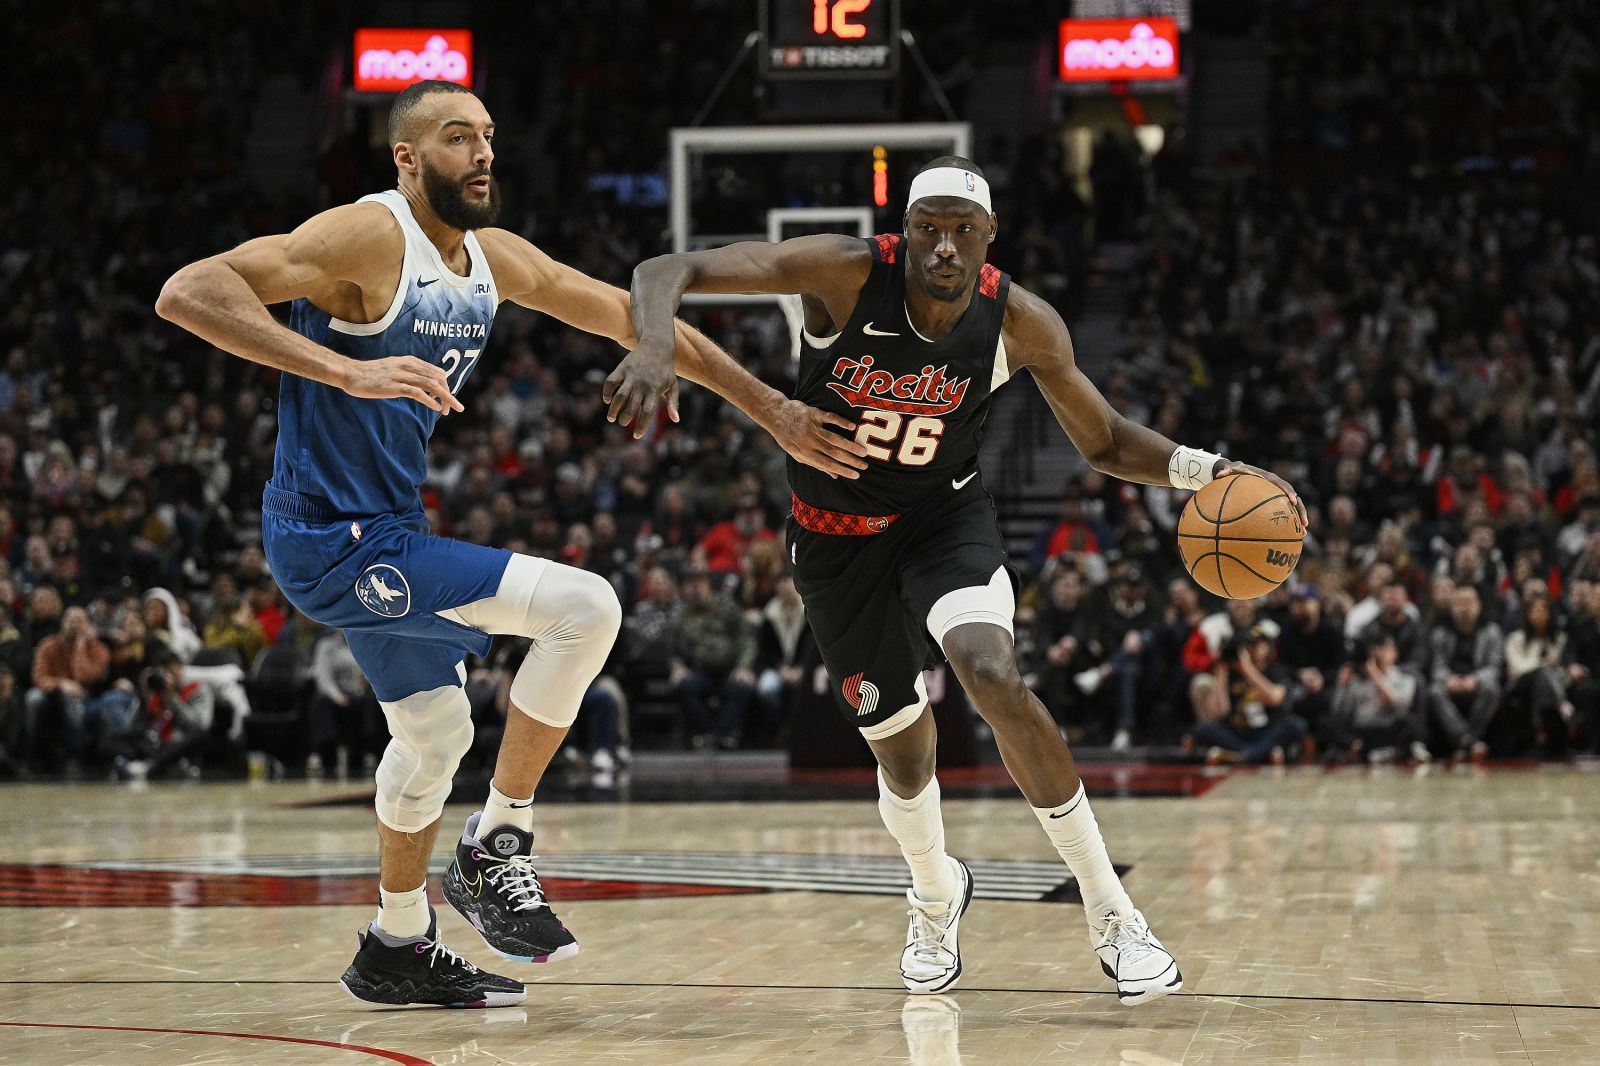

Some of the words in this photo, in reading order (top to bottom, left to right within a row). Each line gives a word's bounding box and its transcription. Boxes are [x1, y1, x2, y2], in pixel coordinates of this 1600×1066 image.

[358, 35, 468, 80] moda
[1064, 22, 1174, 70] moda
[413, 318, 486, 338] MINNESOTA
[442, 348, 481, 395] 27
[854, 410, 945, 465] 26
